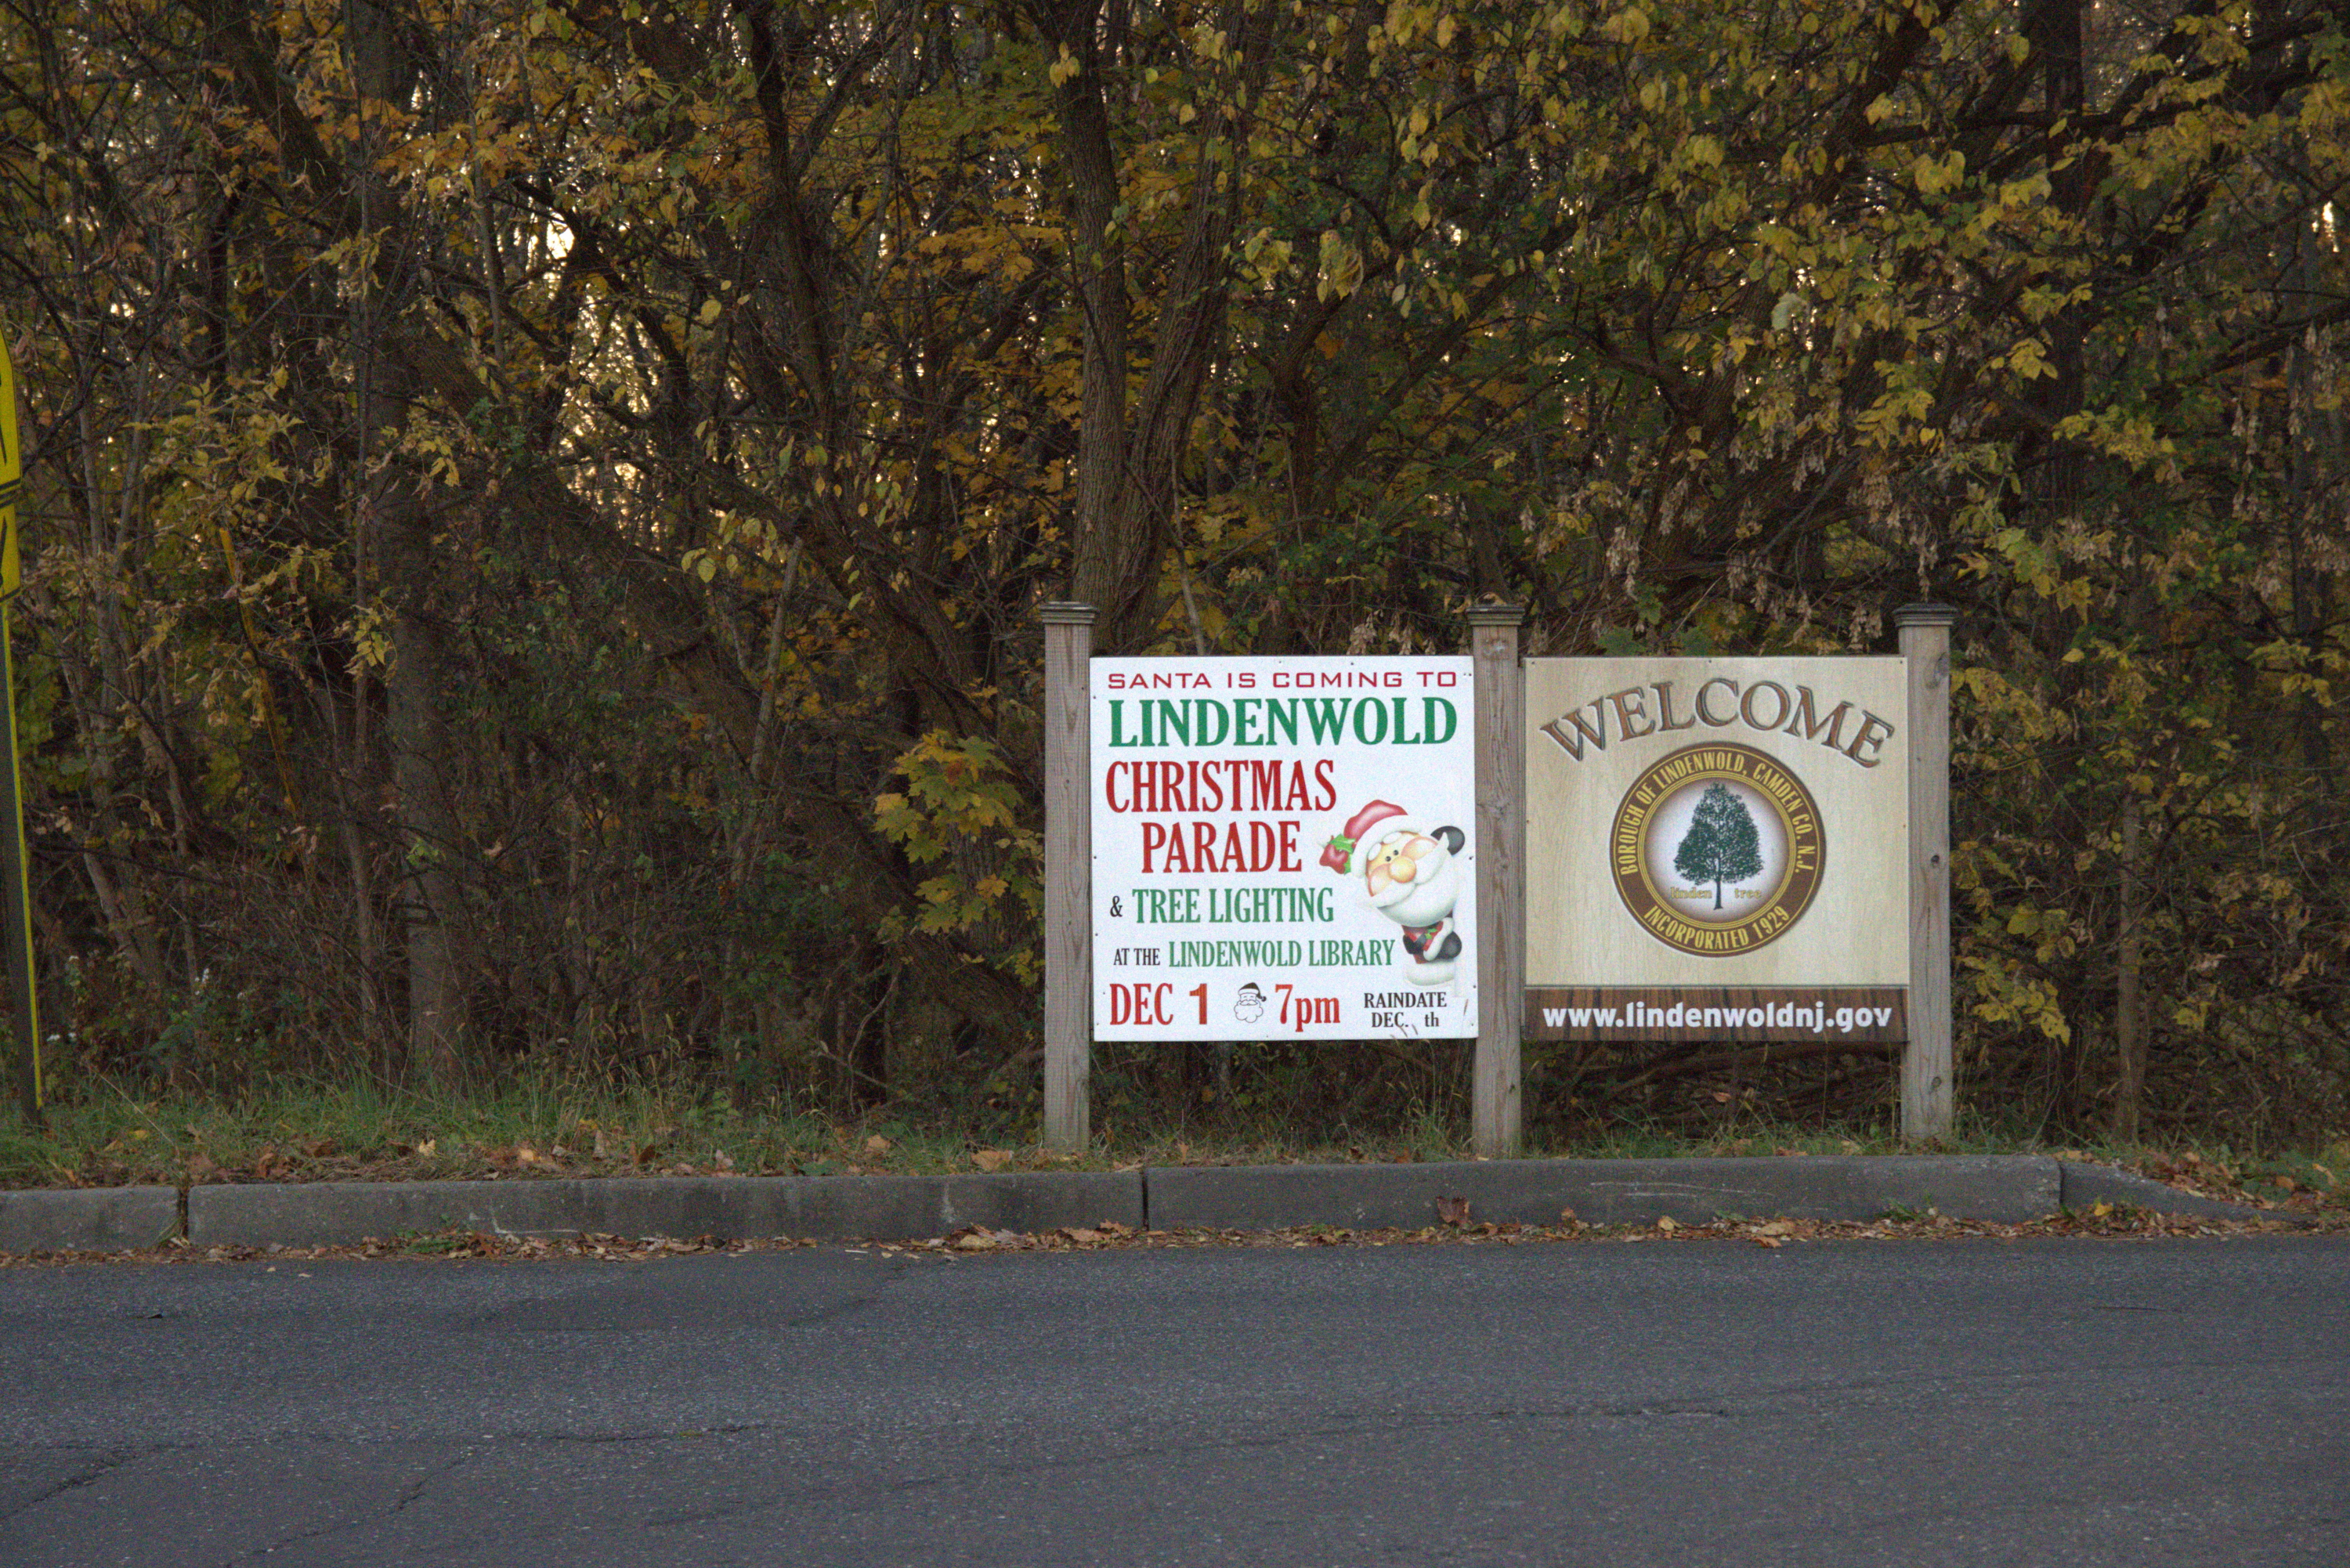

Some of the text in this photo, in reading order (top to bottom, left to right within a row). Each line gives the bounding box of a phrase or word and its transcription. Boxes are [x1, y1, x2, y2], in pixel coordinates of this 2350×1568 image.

[1108, 671, 1456, 689] SANTA IS COMING TO
[1108, 697, 1457, 747] LINDENWOLD
[1539, 677, 1895, 768] WELCOME
[1106, 759, 1336, 813] CHRISTMAS
[1618, 752, 1815, 876] BOROUGH OF LINDENWOLD, CAMDEN CO. N.J.
[1141, 820, 1302, 873] PARADE
[1109, 887, 1333, 923] & TREE LIGHTING
[1670, 887, 1762, 899] linden tree
[1644, 905, 1790, 950] INCORPORATED 1929
[1113, 939, 1395, 967] AT THE LINDENWOLD LIBRARY
[1109, 982, 1340, 1032] DEC 1 7pm
[1364, 992, 1447, 1008] RAINDATE
[1372, 1012, 1439, 1028] DEC. th
[1543, 1001, 1892, 1033] www.lindenwoldnj.gov
